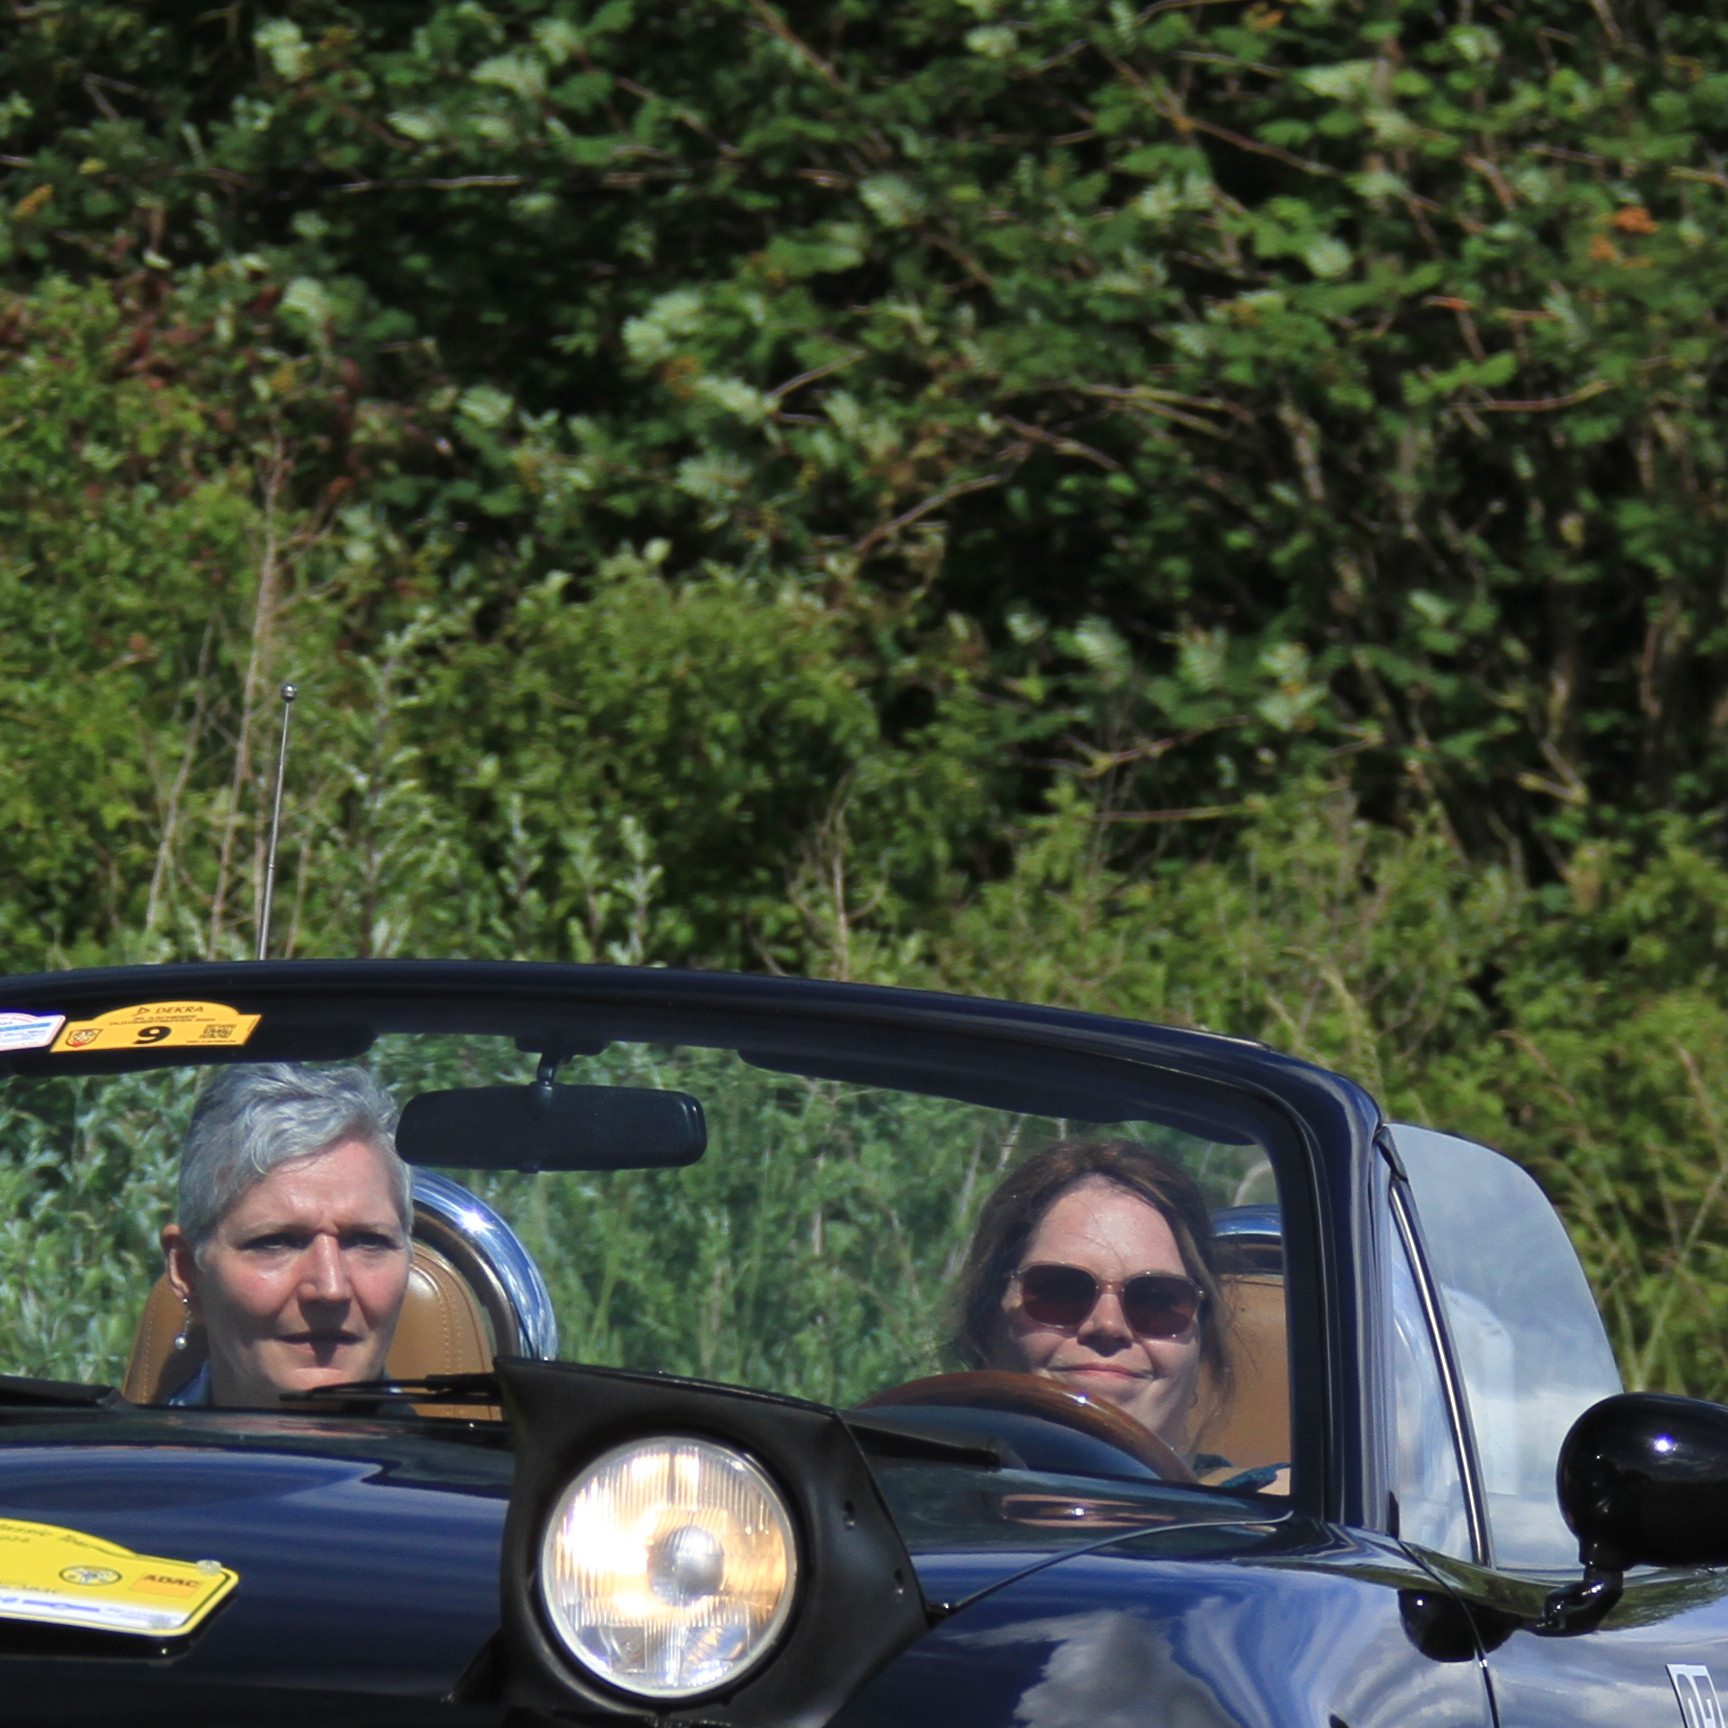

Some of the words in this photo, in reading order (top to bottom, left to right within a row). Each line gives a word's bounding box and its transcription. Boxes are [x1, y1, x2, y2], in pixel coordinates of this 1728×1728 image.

[155, 1005, 204, 1014] DEKRA
[133, 1025, 172, 1044] 9
[145, 1573, 200, 1587] ADAC
